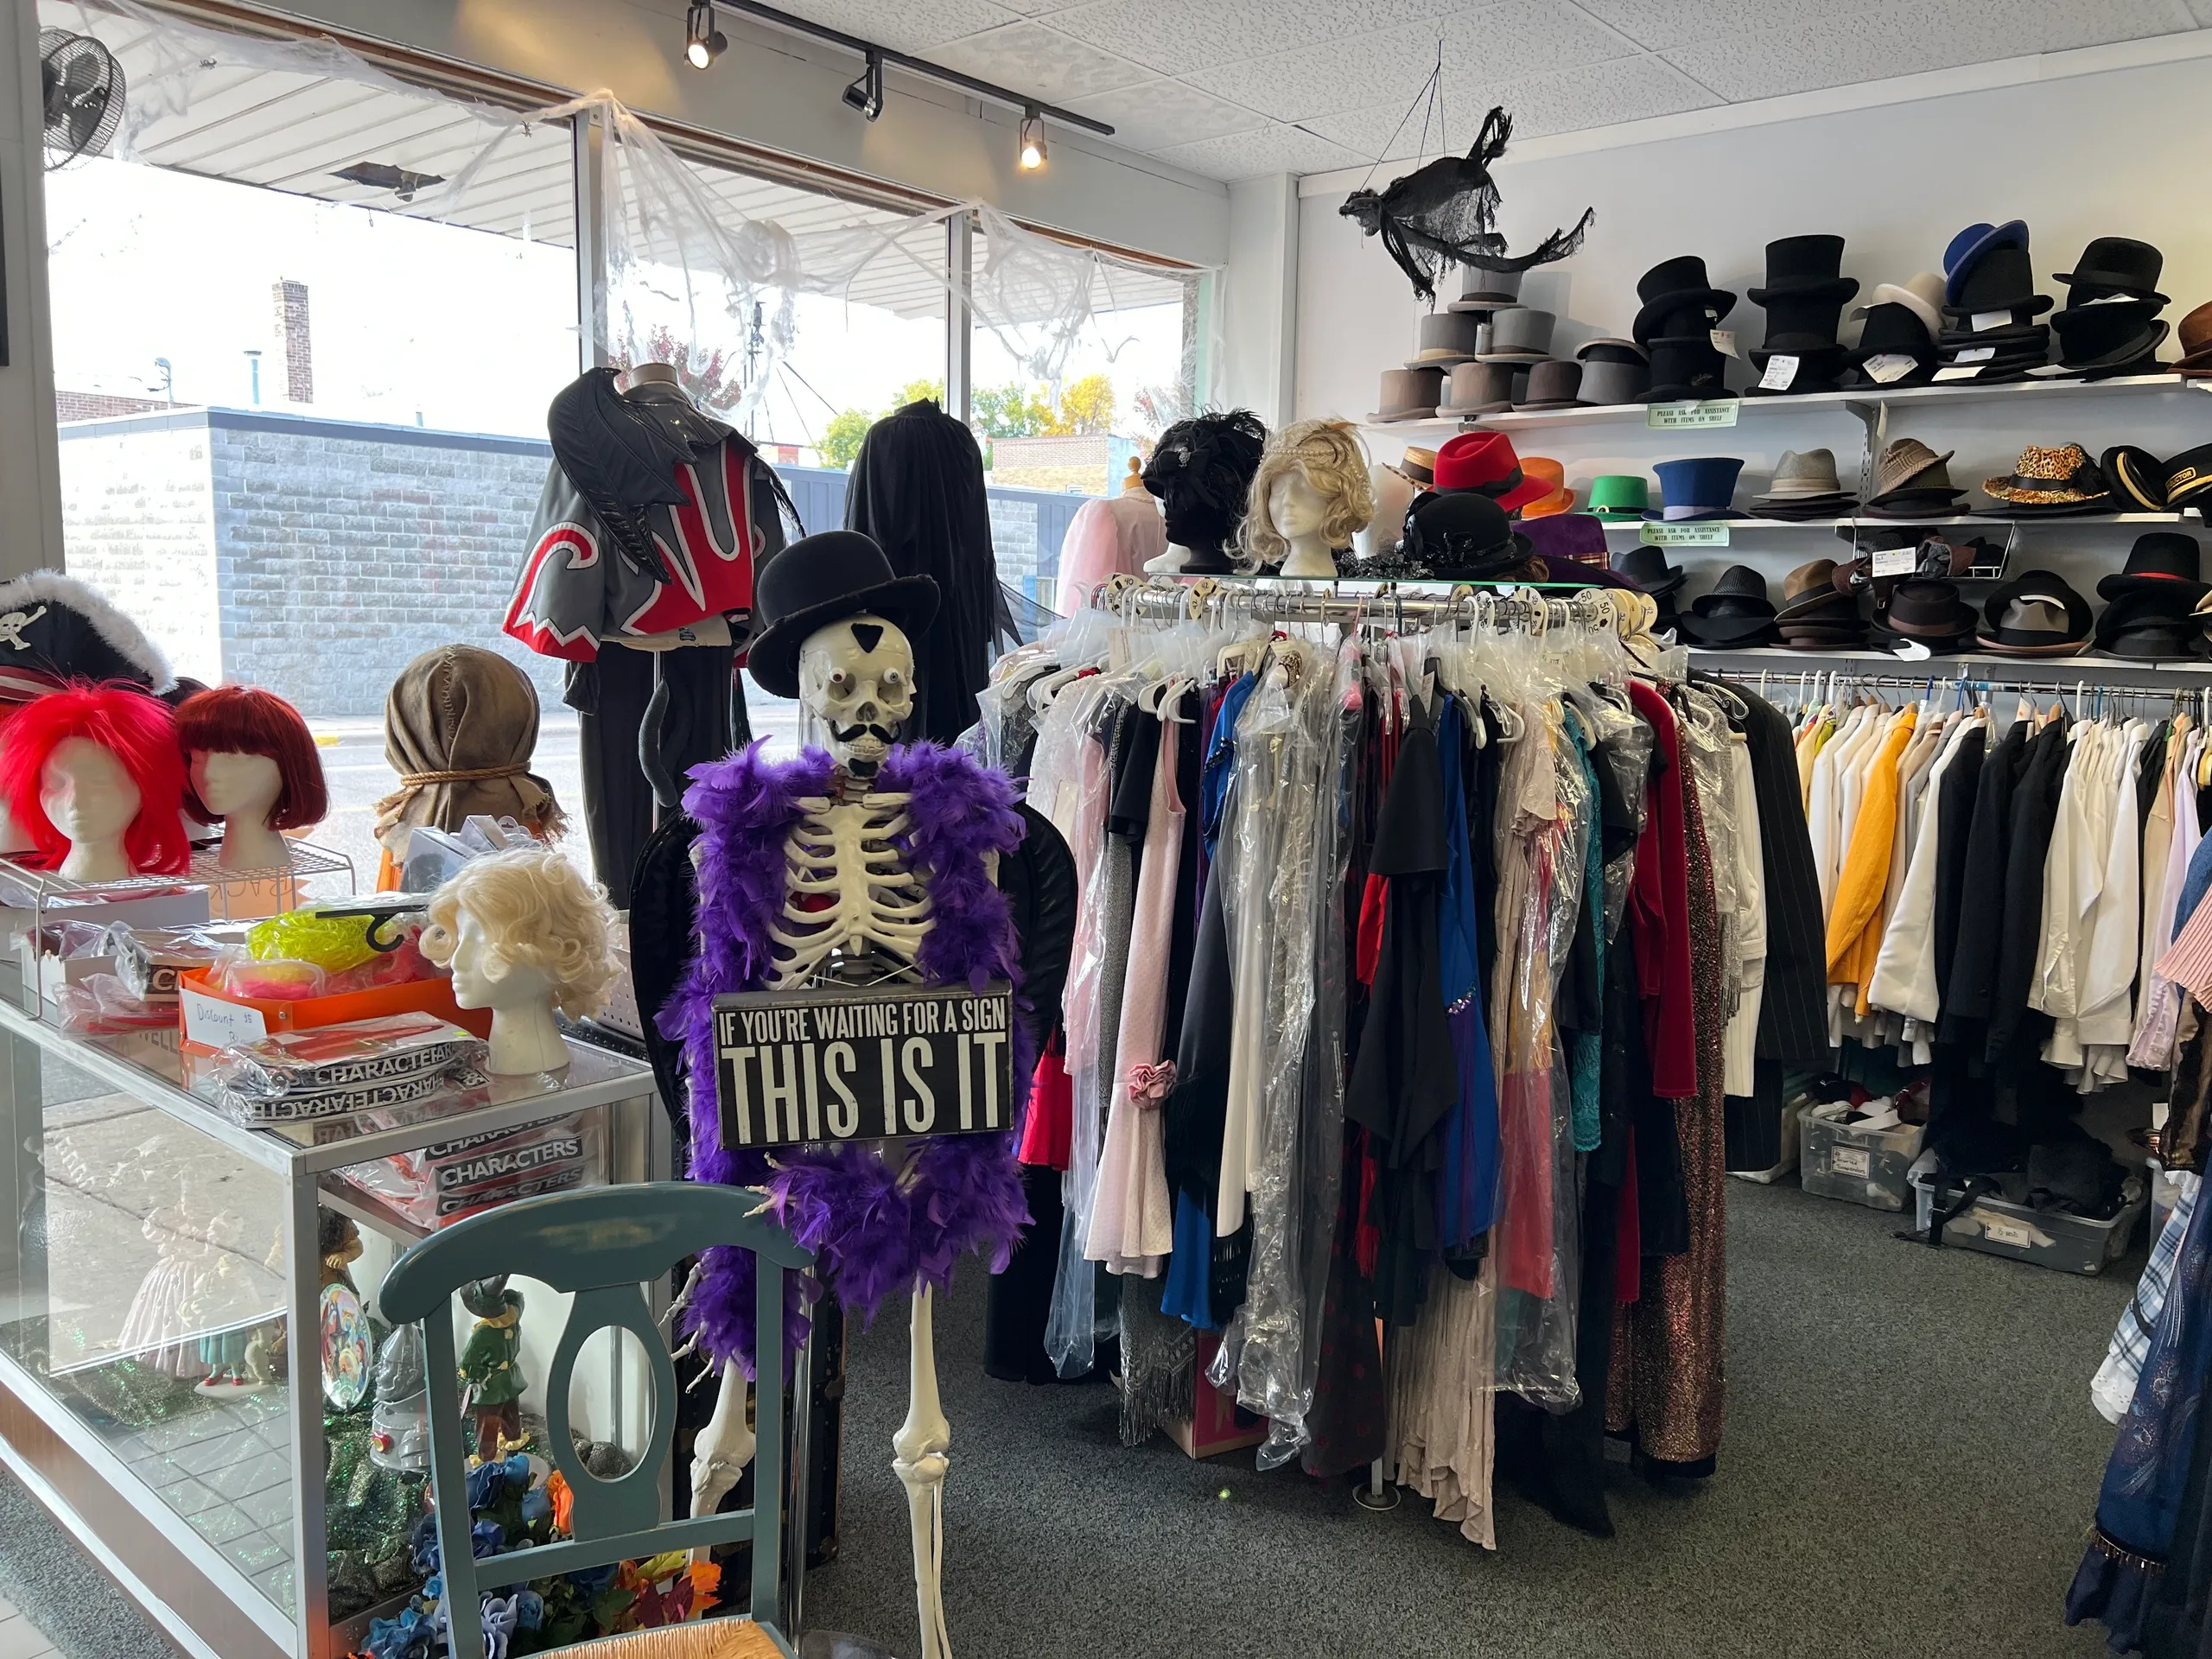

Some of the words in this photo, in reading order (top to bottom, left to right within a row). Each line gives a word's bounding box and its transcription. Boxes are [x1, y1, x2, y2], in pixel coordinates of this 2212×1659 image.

[1581, 590, 1592, 602] 50
[1600, 602, 1610, 614] 50
[1588, 624, 1599, 635] 50
[197, 1003, 234, 1027] Discount
[719, 1012, 735, 1046] IF
[741, 1008, 810, 1044] YOU'RE
[814, 1003, 899, 1039] WAITING
[903, 1001, 939, 1035] FOR
[944, 1001, 957, 1033] A
[961, 997, 1006, 1031] SIGN
[721, 1041, 859, 1145] THIS
[880, 1036, 936, 1135] IS
[957, 1032, 1007, 1130] IT
[441, 1140, 579, 1186] CHARACTERS
